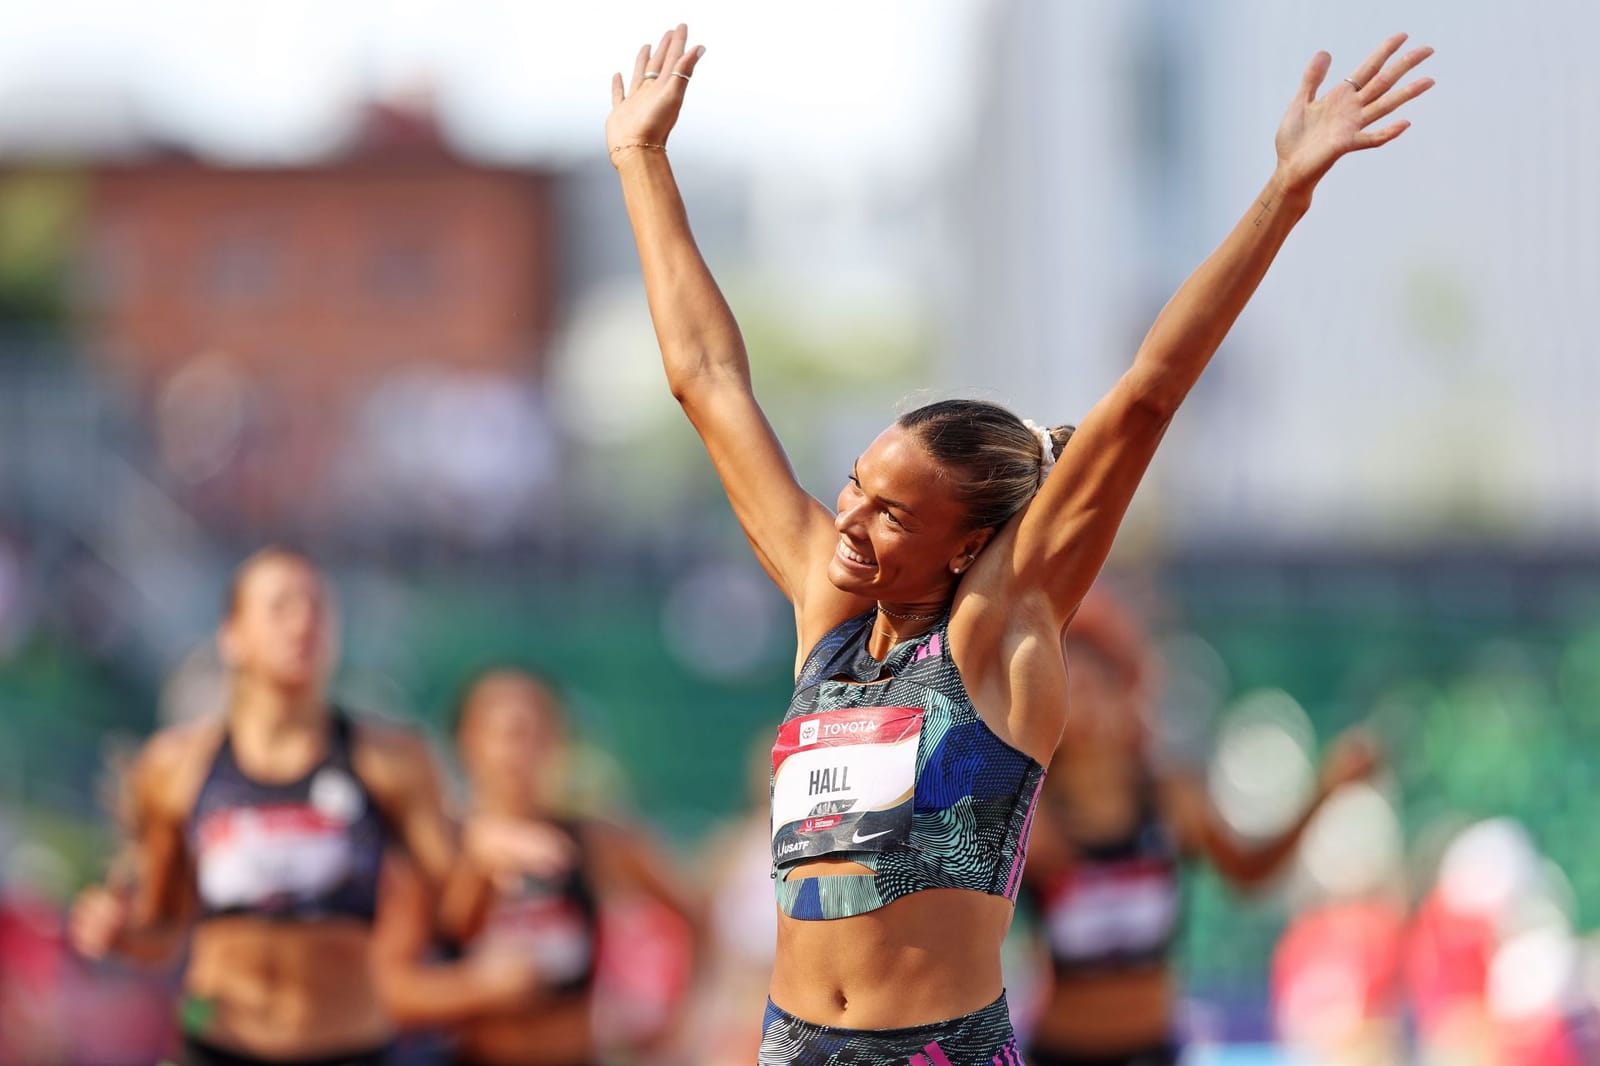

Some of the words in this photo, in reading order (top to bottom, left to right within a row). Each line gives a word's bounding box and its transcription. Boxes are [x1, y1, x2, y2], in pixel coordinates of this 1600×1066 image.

[823, 720, 876, 736] TOYOTA
[809, 766, 851, 796] HALL
[784, 841, 809, 854] USATF
